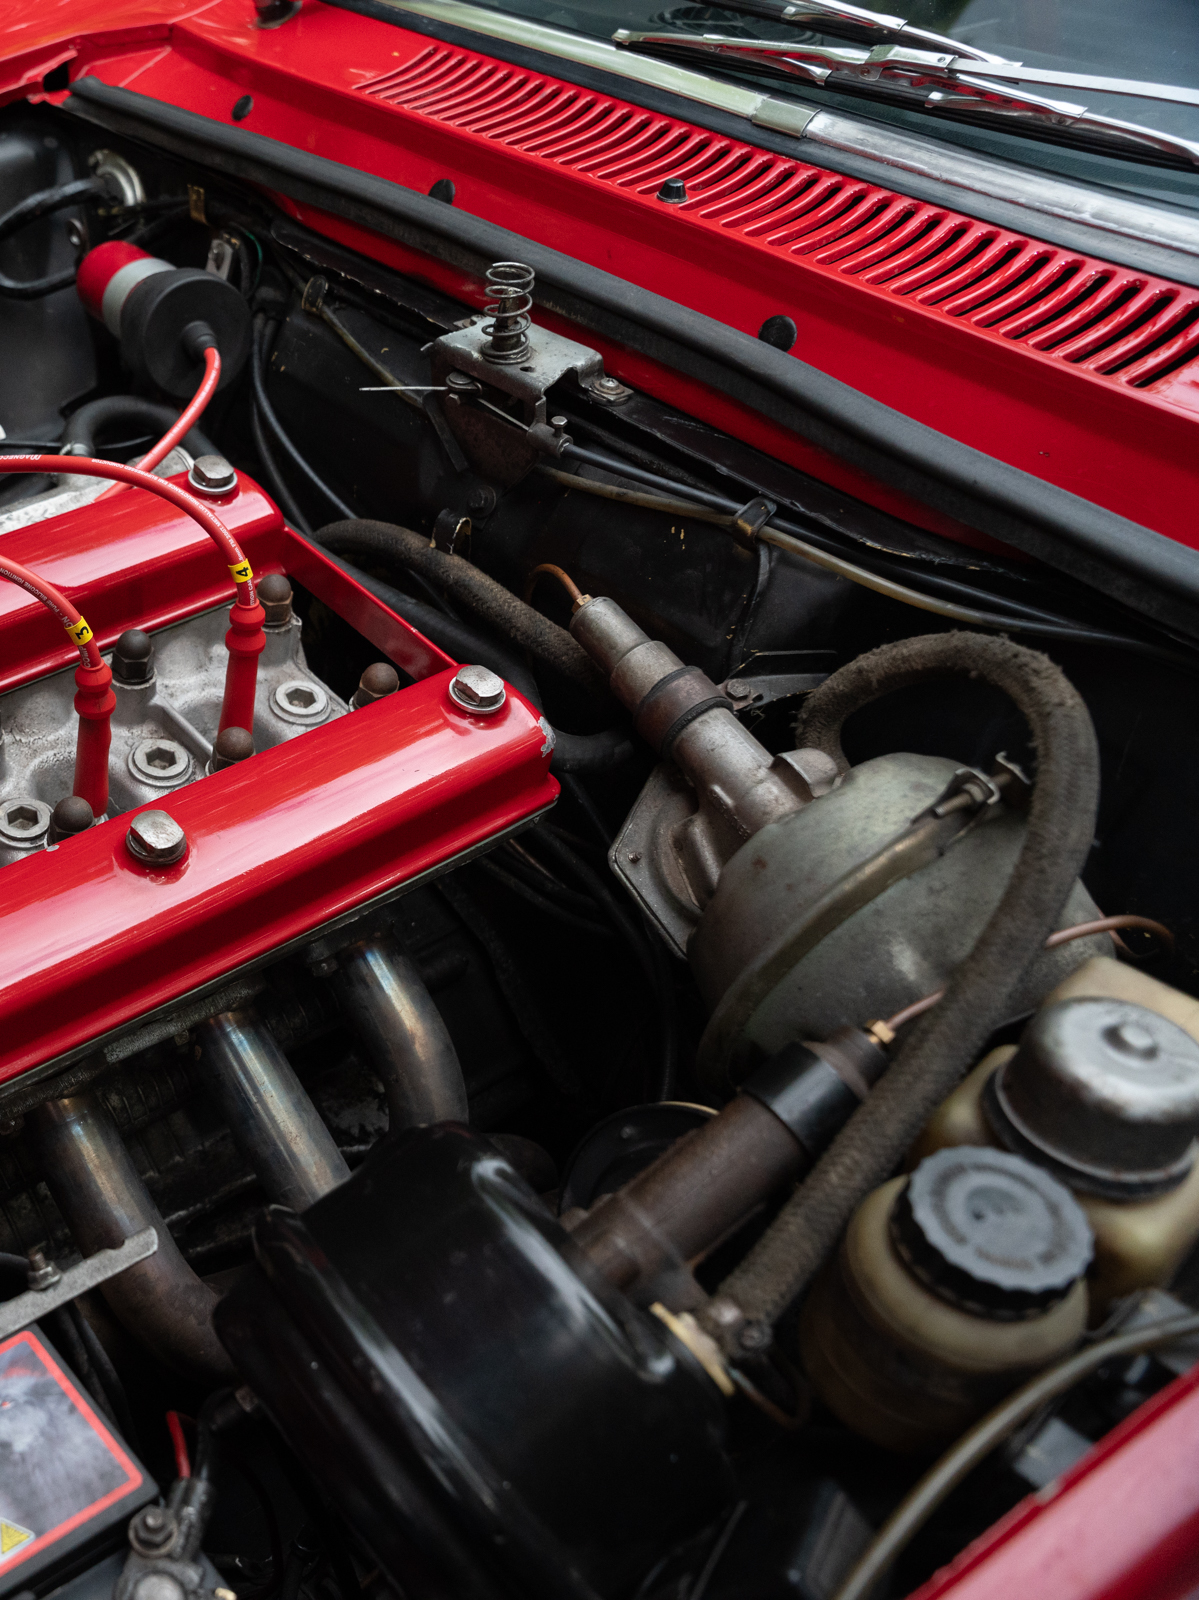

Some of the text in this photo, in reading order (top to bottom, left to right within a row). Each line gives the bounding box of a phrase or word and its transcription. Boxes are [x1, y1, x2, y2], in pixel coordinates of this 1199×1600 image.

[124, 466, 158, 481] SUPPRESSED
[167, 482, 200, 506] INDUCTANCE
[199, 504, 222, 528] METALLIC
[0, 568, 25, 585] IGNITION
[235, 566, 250, 577] 4
[24, 581, 48, 602] SILICONE
[74, 625, 90, 640] 3
